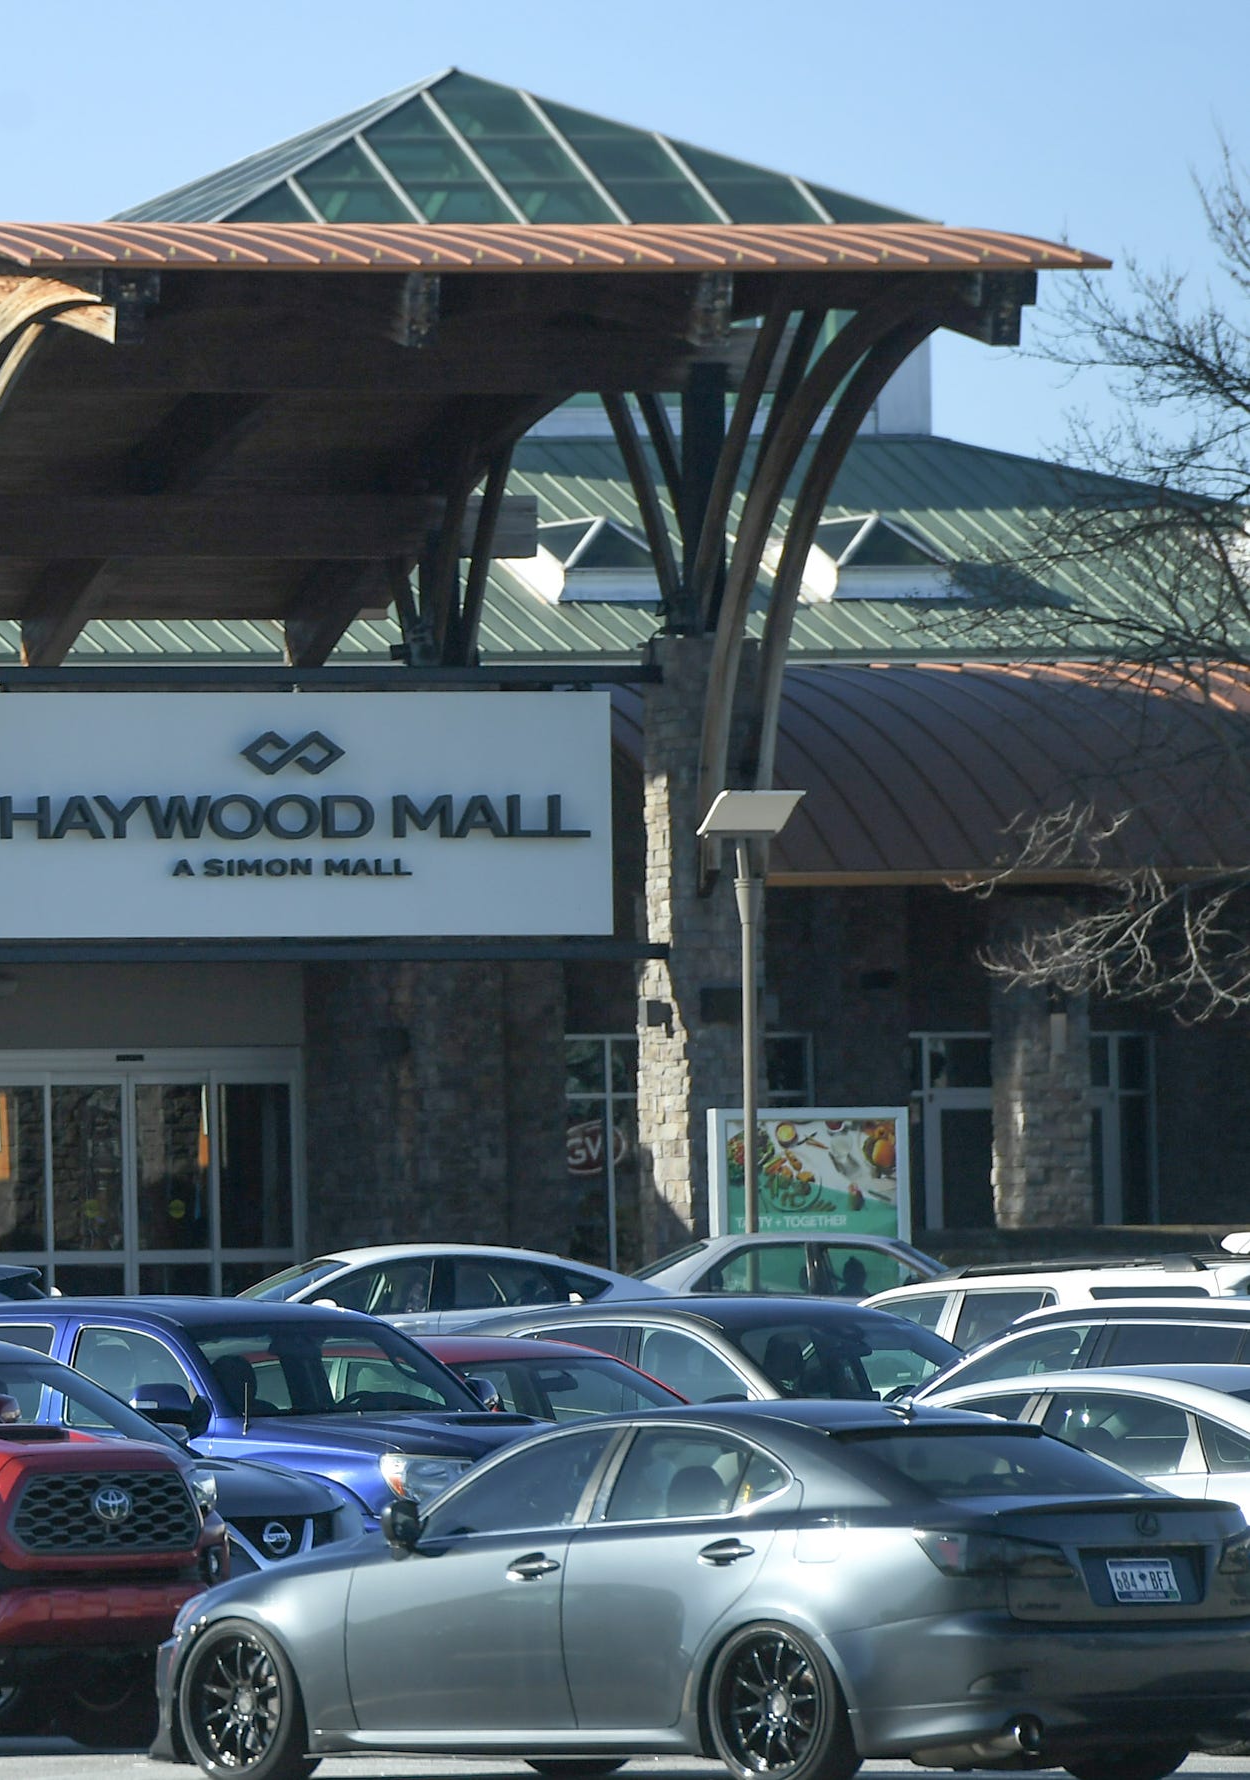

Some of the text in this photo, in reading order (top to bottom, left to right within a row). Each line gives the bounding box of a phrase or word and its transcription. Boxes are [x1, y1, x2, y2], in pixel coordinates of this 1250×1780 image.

[0, 794, 591, 839] HAYWOOD MALL
[172, 858, 412, 876] A SIMON MALL
[735, 1216, 772, 1229] TTY
[783, 1214, 847, 1228] TOGETHER
[1114, 1571, 1138, 1591] 684
